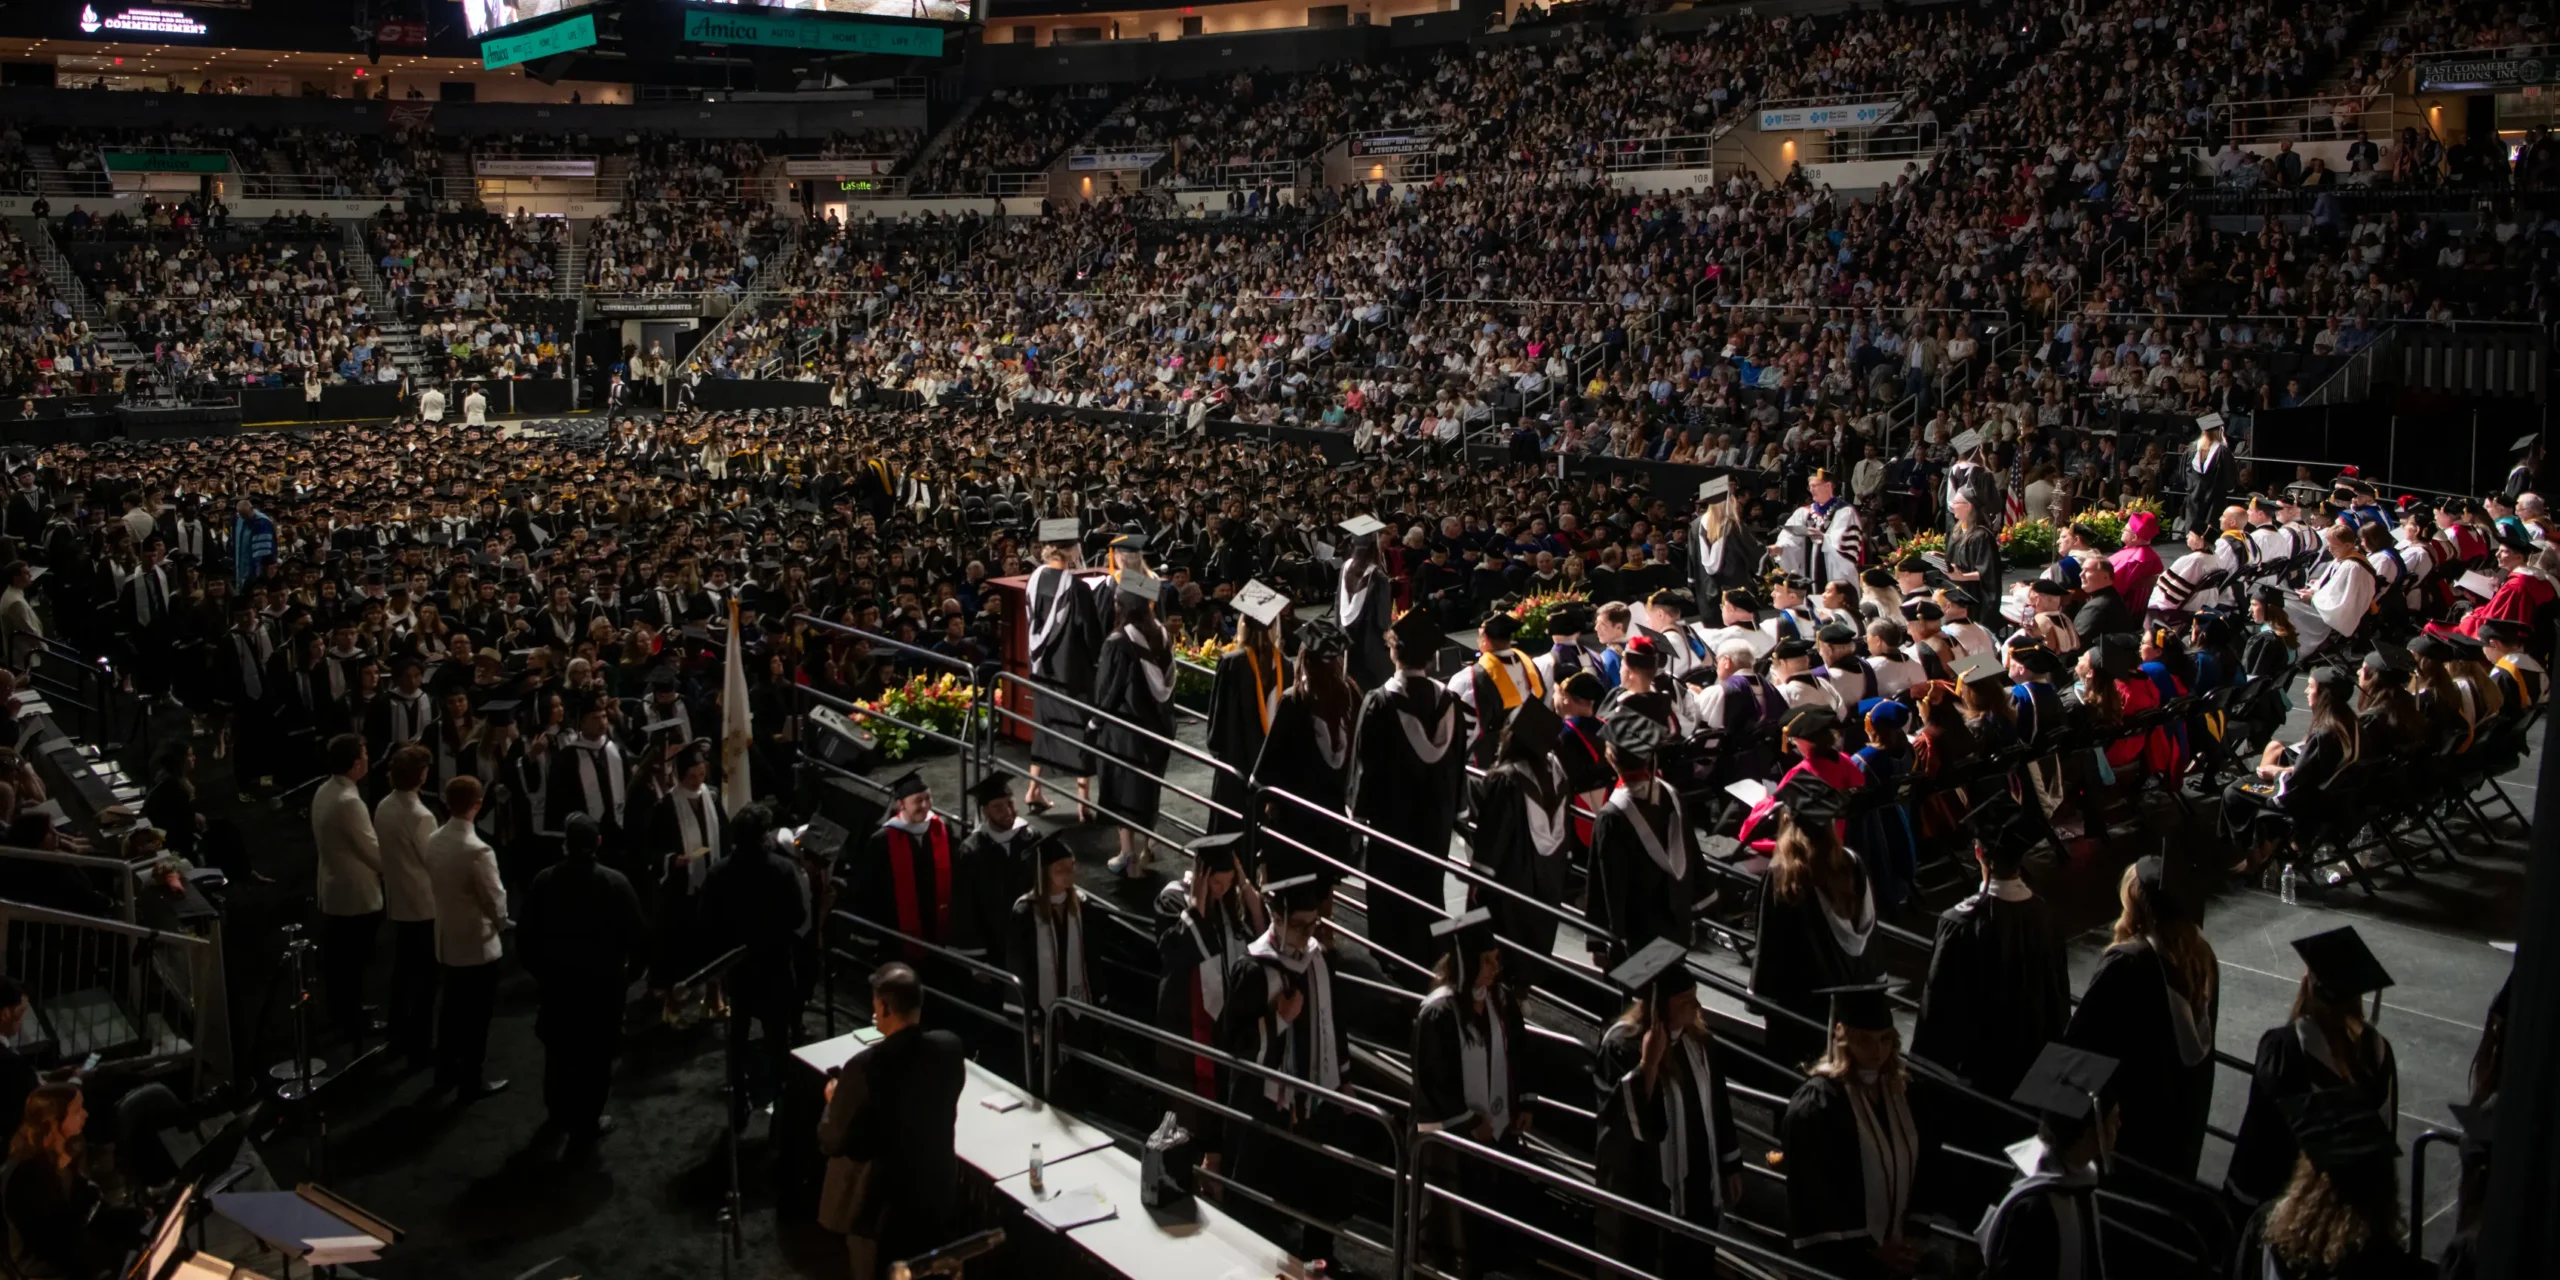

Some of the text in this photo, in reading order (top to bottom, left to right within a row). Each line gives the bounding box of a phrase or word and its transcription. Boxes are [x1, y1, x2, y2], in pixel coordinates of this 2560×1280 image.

[1740, 7, 1752, 16] 210
[104, 19, 206, 34] COMMENCEMENT
[691, 16, 909, 47] Amica AUTO HOME LIFE
[486, 44, 509, 65] Amica
[2425, 61, 2518, 75] EAST COMMERCE
[2425, 70, 2518, 82] SOLUTIONS, INC
[142, 155, 189, 169] Amica
[1693, 174, 1708, 184] 108
[1805, 169, 1821, 179] 108
[841, 181, 871, 190] LaSalle
[658, 303, 692, 311] GRADUATES
